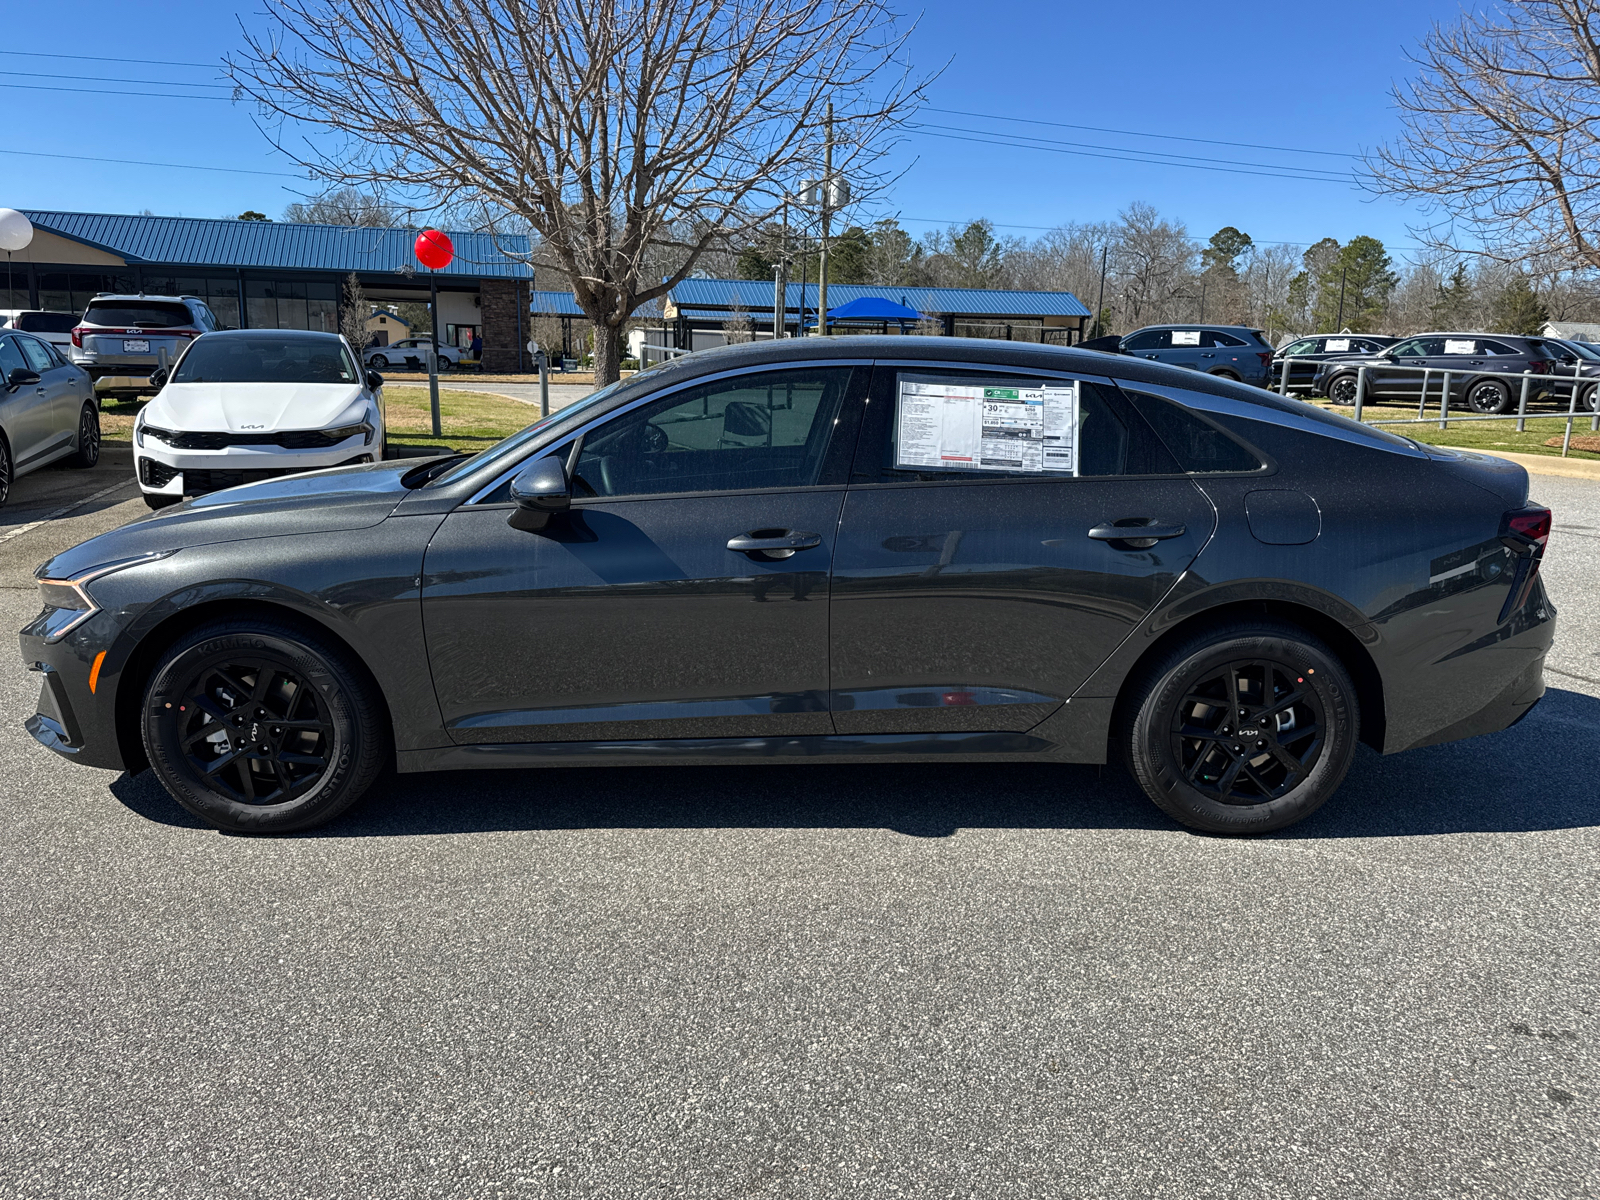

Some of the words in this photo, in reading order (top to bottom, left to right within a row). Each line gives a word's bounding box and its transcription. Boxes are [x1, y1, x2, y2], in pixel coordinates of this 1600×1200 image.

[987, 404, 998, 412] 30
[197, 637, 266, 657] KUMHO
[1157, 660, 1201, 715] KUMHO
[1321, 673, 1347, 731] SOLUS
[319, 742, 353, 799] SOLUS
